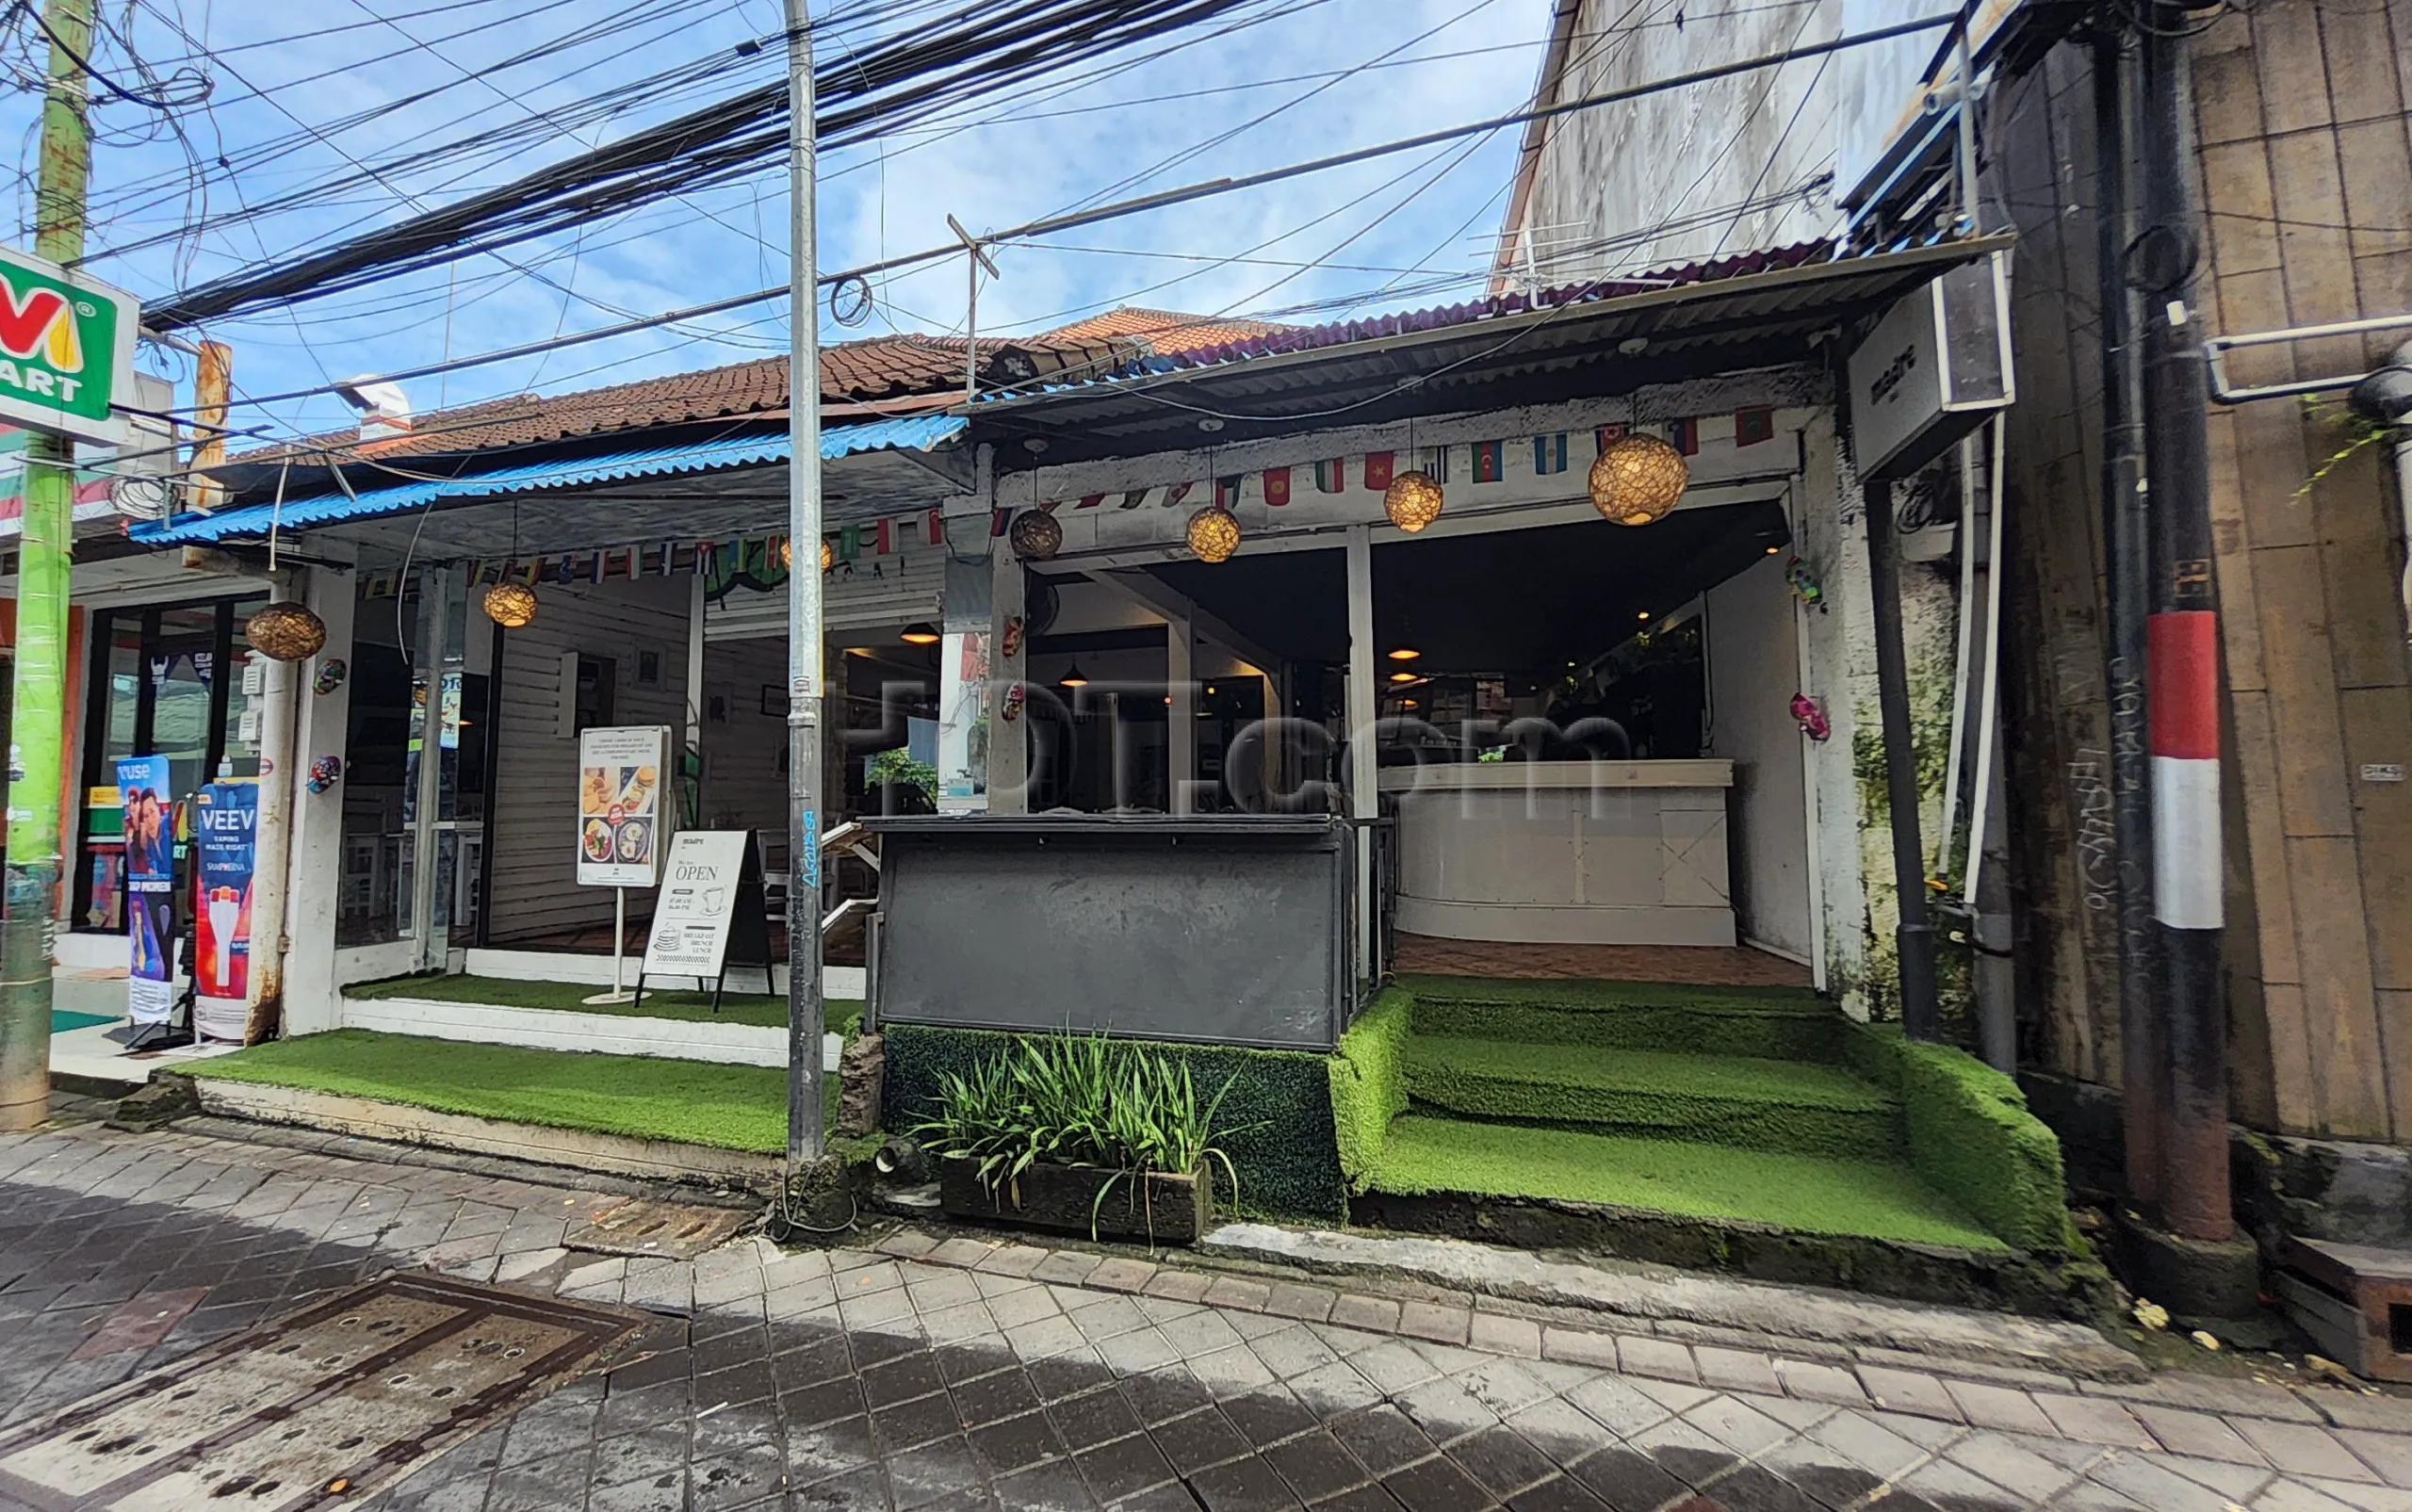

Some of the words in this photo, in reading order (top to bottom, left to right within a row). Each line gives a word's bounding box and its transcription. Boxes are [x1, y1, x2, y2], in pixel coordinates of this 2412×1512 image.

[0, 359, 83, 402] ART
[201, 809, 255, 831] VEEV
[173, 845, 187, 859] RT
[676, 866, 718, 881] OPEN
